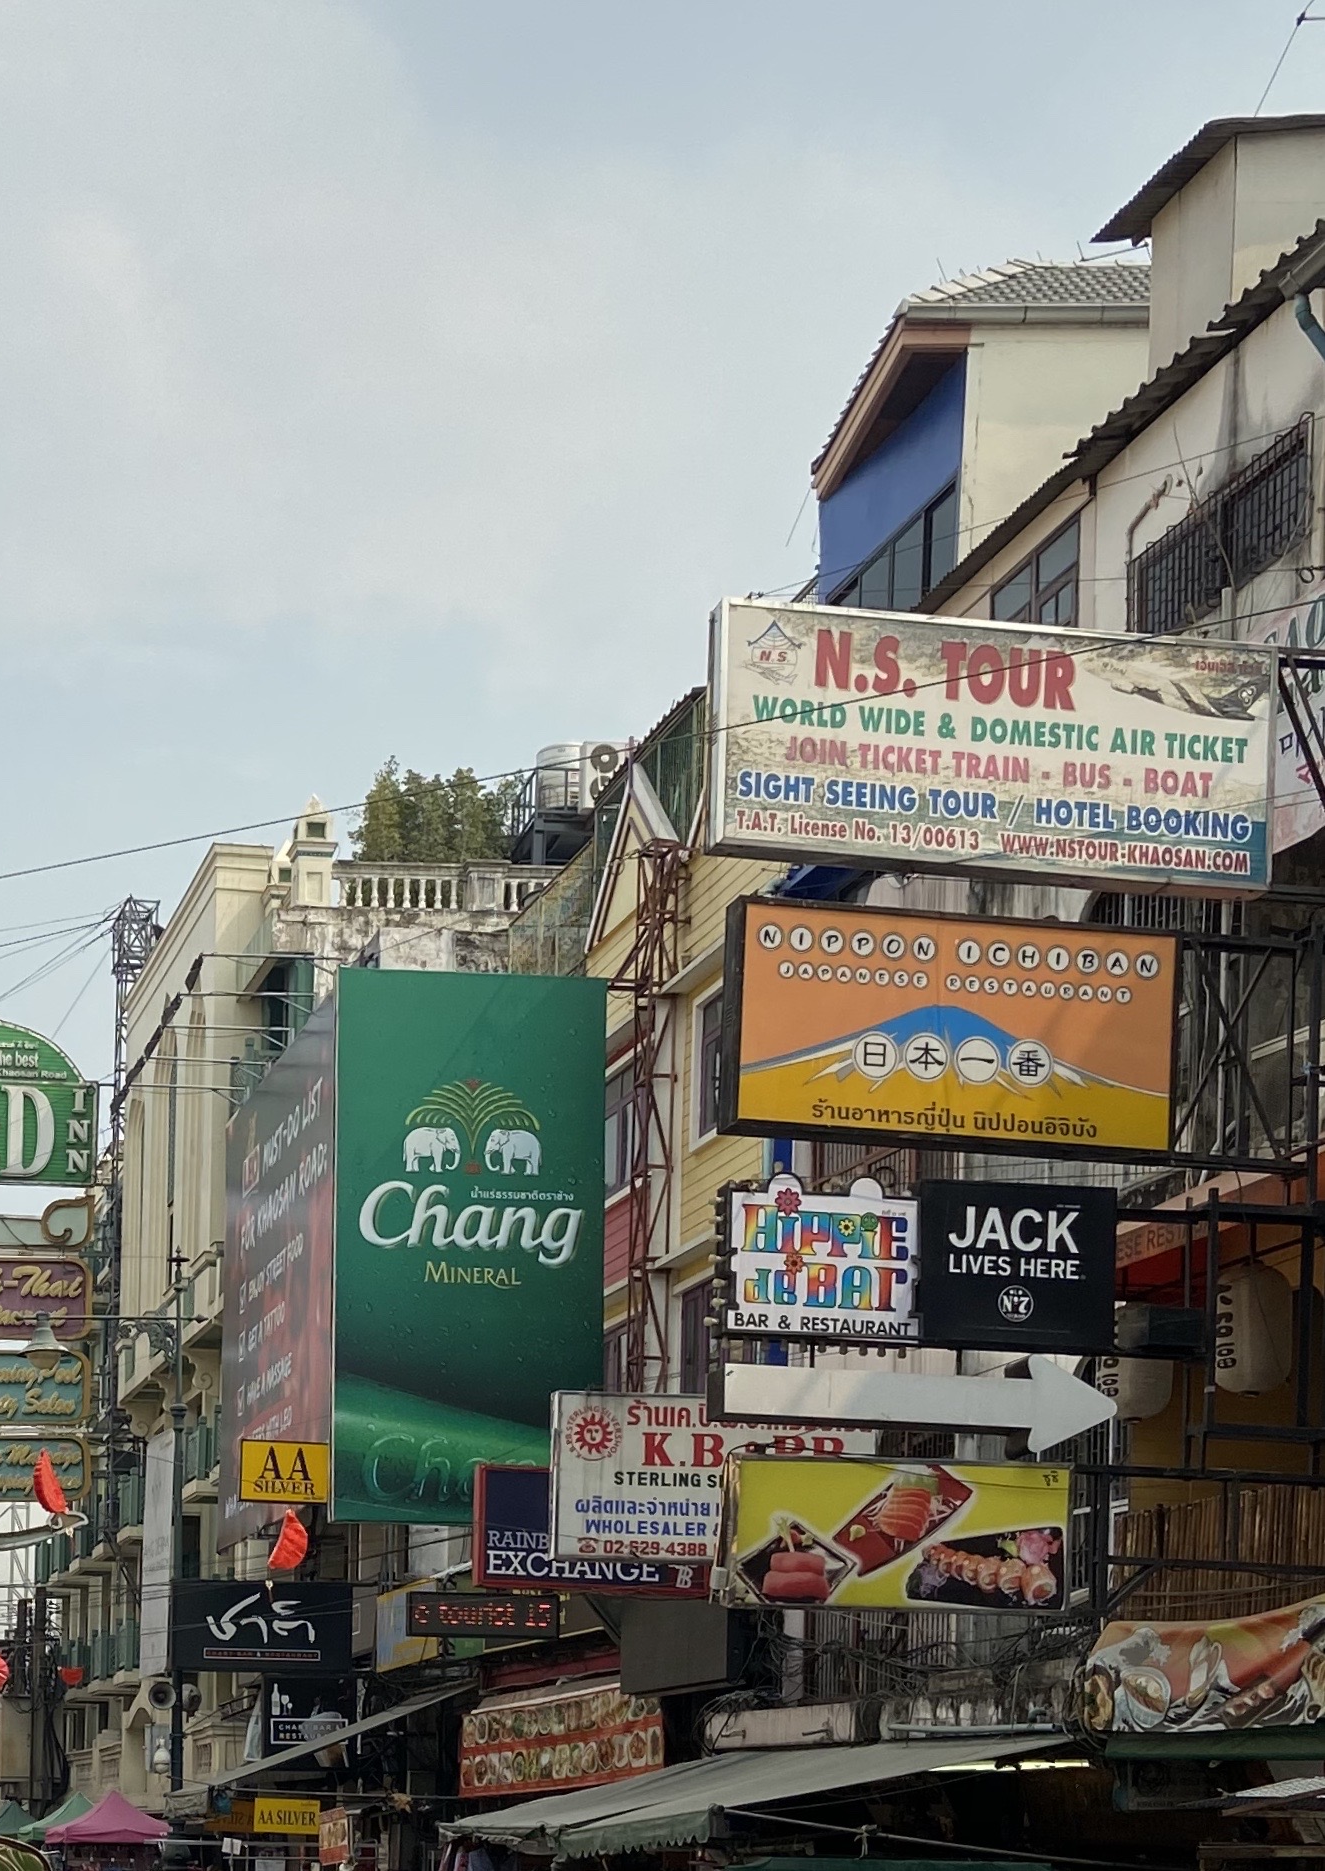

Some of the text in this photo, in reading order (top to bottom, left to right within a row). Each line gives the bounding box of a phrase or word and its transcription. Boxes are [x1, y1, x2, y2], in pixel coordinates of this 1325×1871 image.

[814, 628, 1076, 712] N.S. TOUR
[753, 695, 1248, 764] WORLD WIDE & DOMESTIC AIR TICKET
[785, 736, 847, 767] JOIN
[858, 743, 941, 776] TICKET
[952, 751, 1029, 783] TRAIN
[1063, 761, 1112, 789] BUS
[1144, 767, 1213, 798] BOAT
[737, 771, 1251, 842] SIGHT SEEING TOUR / HOTEL BOOKING
[737, 810, 782, 833] T.A.T.
[790, 814, 847, 839] License
[854, 820, 881, 842] No.
[890, 823, 980, 850] 13/00613
[760, 925, 1158, 978] NIPPON ICHIBAN
[781, 962, 1131, 1002] JAPANESE RESTAURANT
[15, 1050, 40, 1068] best
[860, 1039, 1047, 1078] 日本一番
[302, 1076, 324, 1132] LIST
[811, 1098, 966, 1131] ร้านอาหารญี่ปุ่น
[65, 1087, 92, 1176] INN
[358, 1180, 584, 1267] Chang
[948, 1205, 1080, 1254] JACK
[949, 1253, 1012, 1277] LIVES
[734, 1312, 911, 1337] BAR & RESTAURANT
[258, 1445, 313, 1481] AA
[614, 1471, 702, 1488] STERLING
[253, 1480, 316, 1496] SILVER
[586, 1519, 707, 1537] WHOLESALER
[487, 1549, 660, 1583] EXCHANGE
[258, 1809, 274, 1825] AA
[276, 1810, 316, 1827] SILVER
